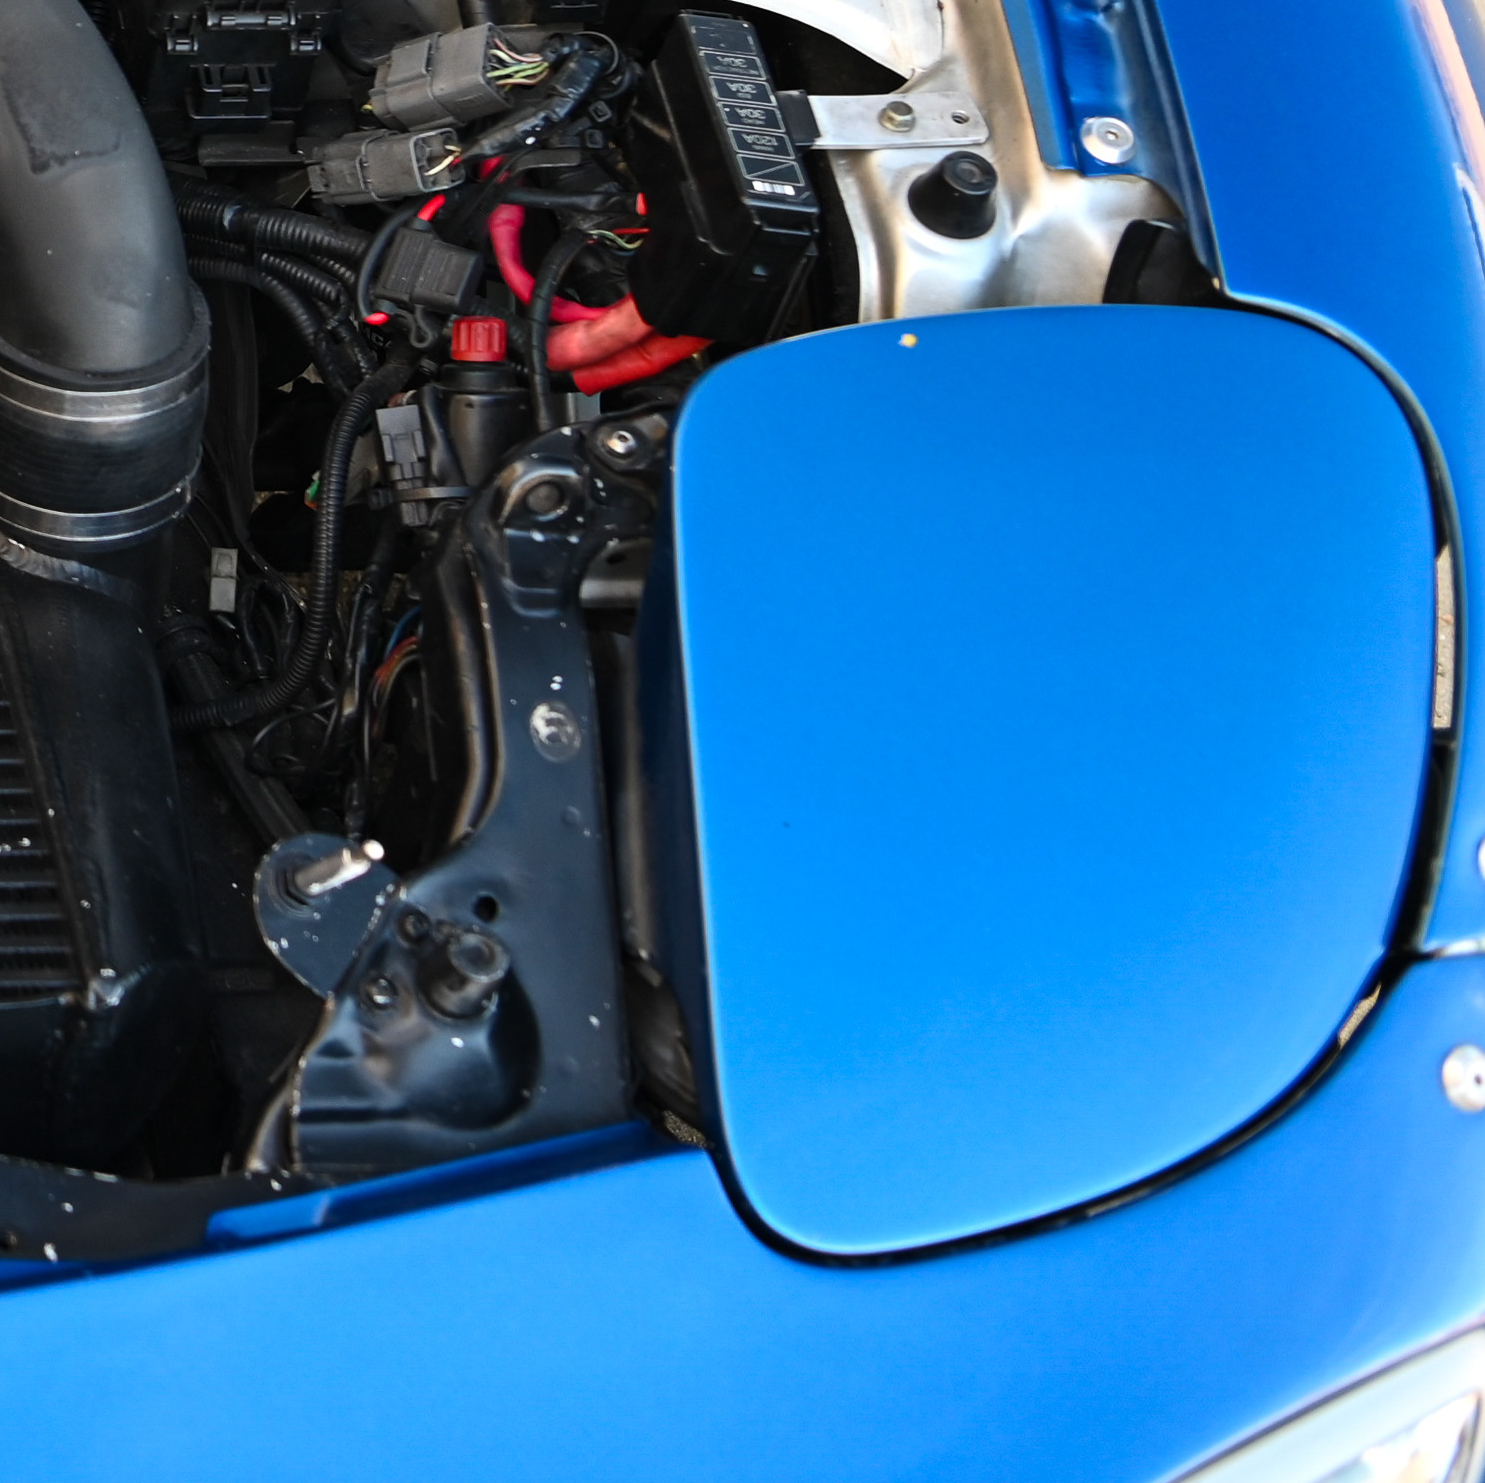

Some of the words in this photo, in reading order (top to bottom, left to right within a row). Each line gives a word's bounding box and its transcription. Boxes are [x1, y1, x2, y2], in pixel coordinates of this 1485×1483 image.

[726, 82, 757, 93] 30A
[734, 107, 766, 119] 30A
[741, 133, 779, 146] 120A
